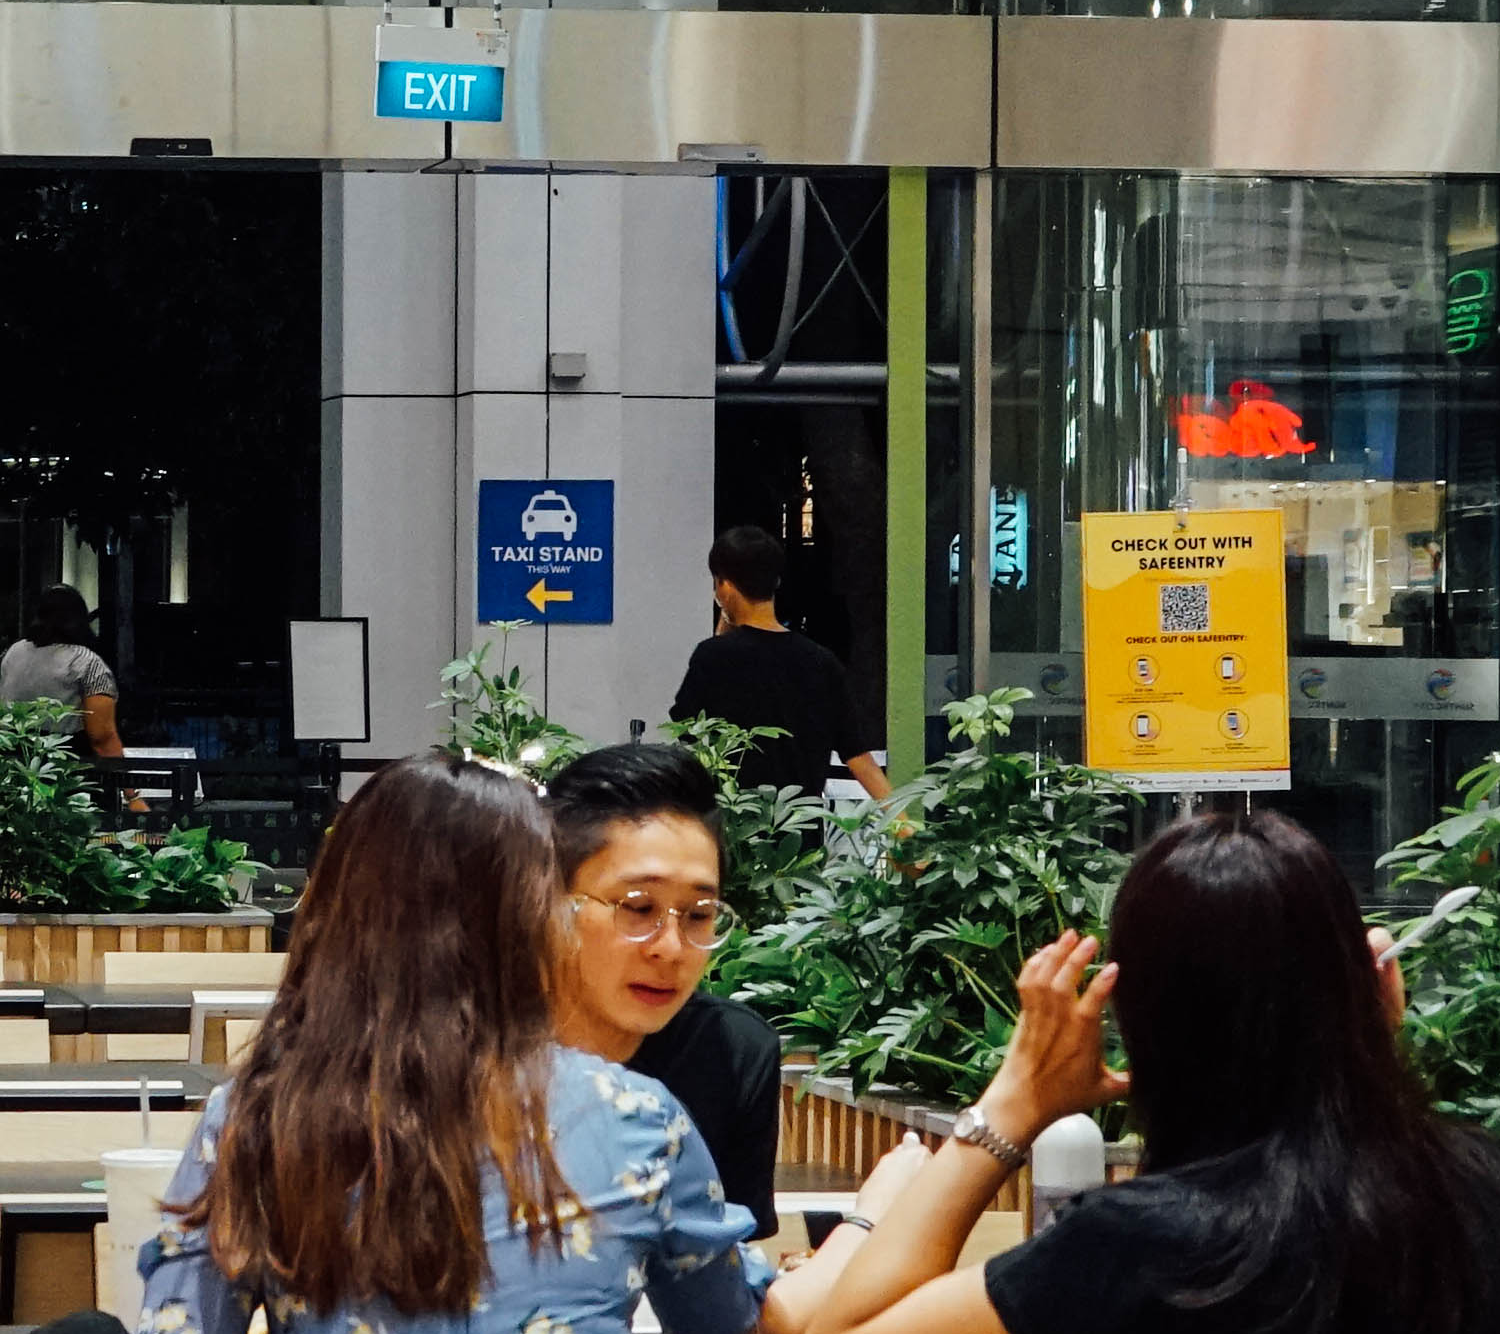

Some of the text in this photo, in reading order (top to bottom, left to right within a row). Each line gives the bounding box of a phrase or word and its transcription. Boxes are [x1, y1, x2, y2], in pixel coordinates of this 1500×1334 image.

[403, 72, 477, 114] EXIT
[1111, 536, 1253, 552] CHECK OUT WITH
[491, 546, 603, 562] TAXI STAND
[527, 564, 572, 574] THIS WAY
[1138, 556, 1226, 570] SAFEENTRY
[1126, 636, 1157, 644] CHECK
[1160, 635, 1178, 643] OUT
[1180, 635, 1195, 643] ON
